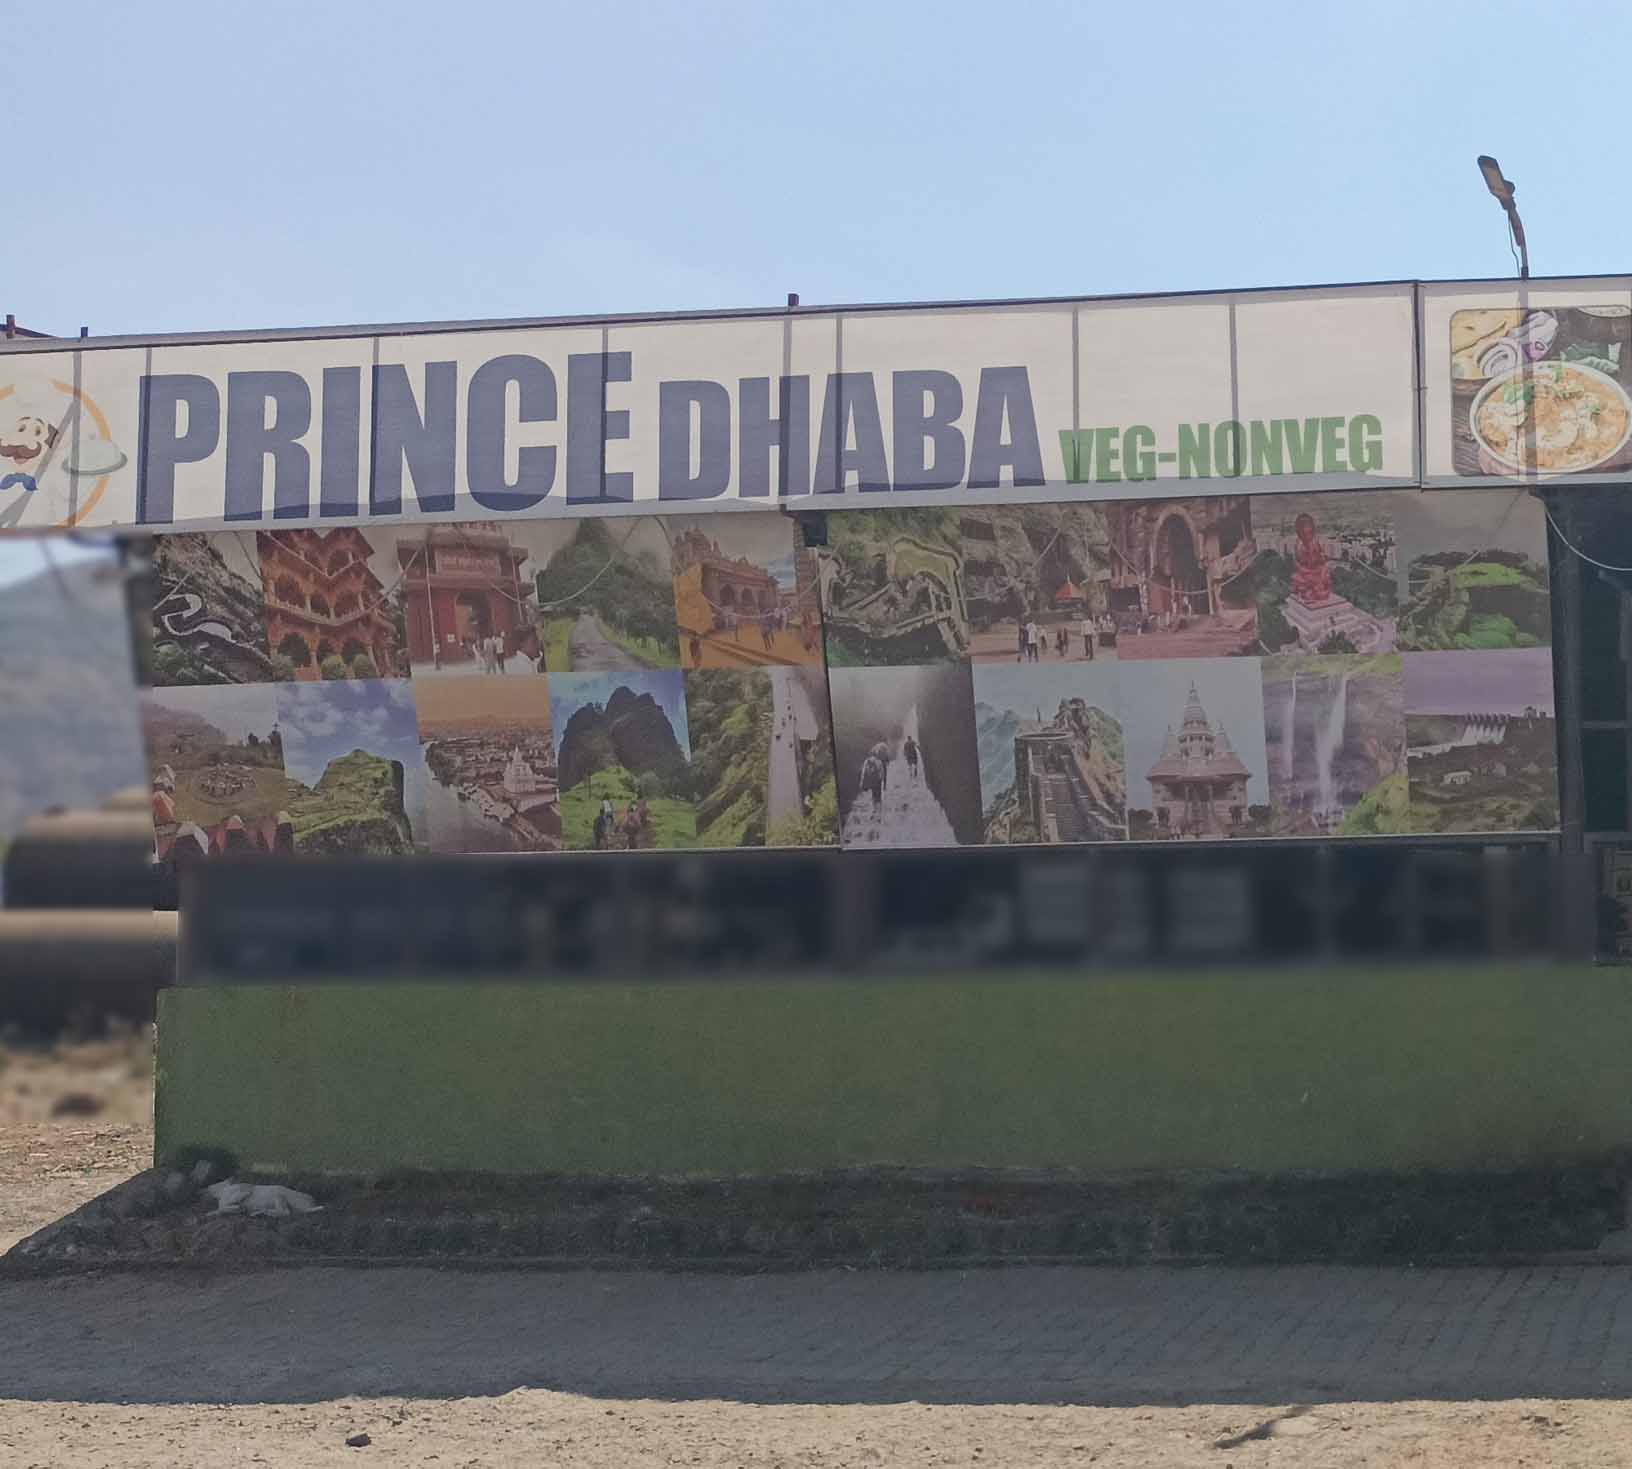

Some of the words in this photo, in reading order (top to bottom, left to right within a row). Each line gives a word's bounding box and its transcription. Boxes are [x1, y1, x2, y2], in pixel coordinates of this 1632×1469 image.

[136, 351, 634, 525] PRINCE
[658, 366, 1046, 501] DHABA
[1058, 414, 1384, 484] VEG-NONVEG
